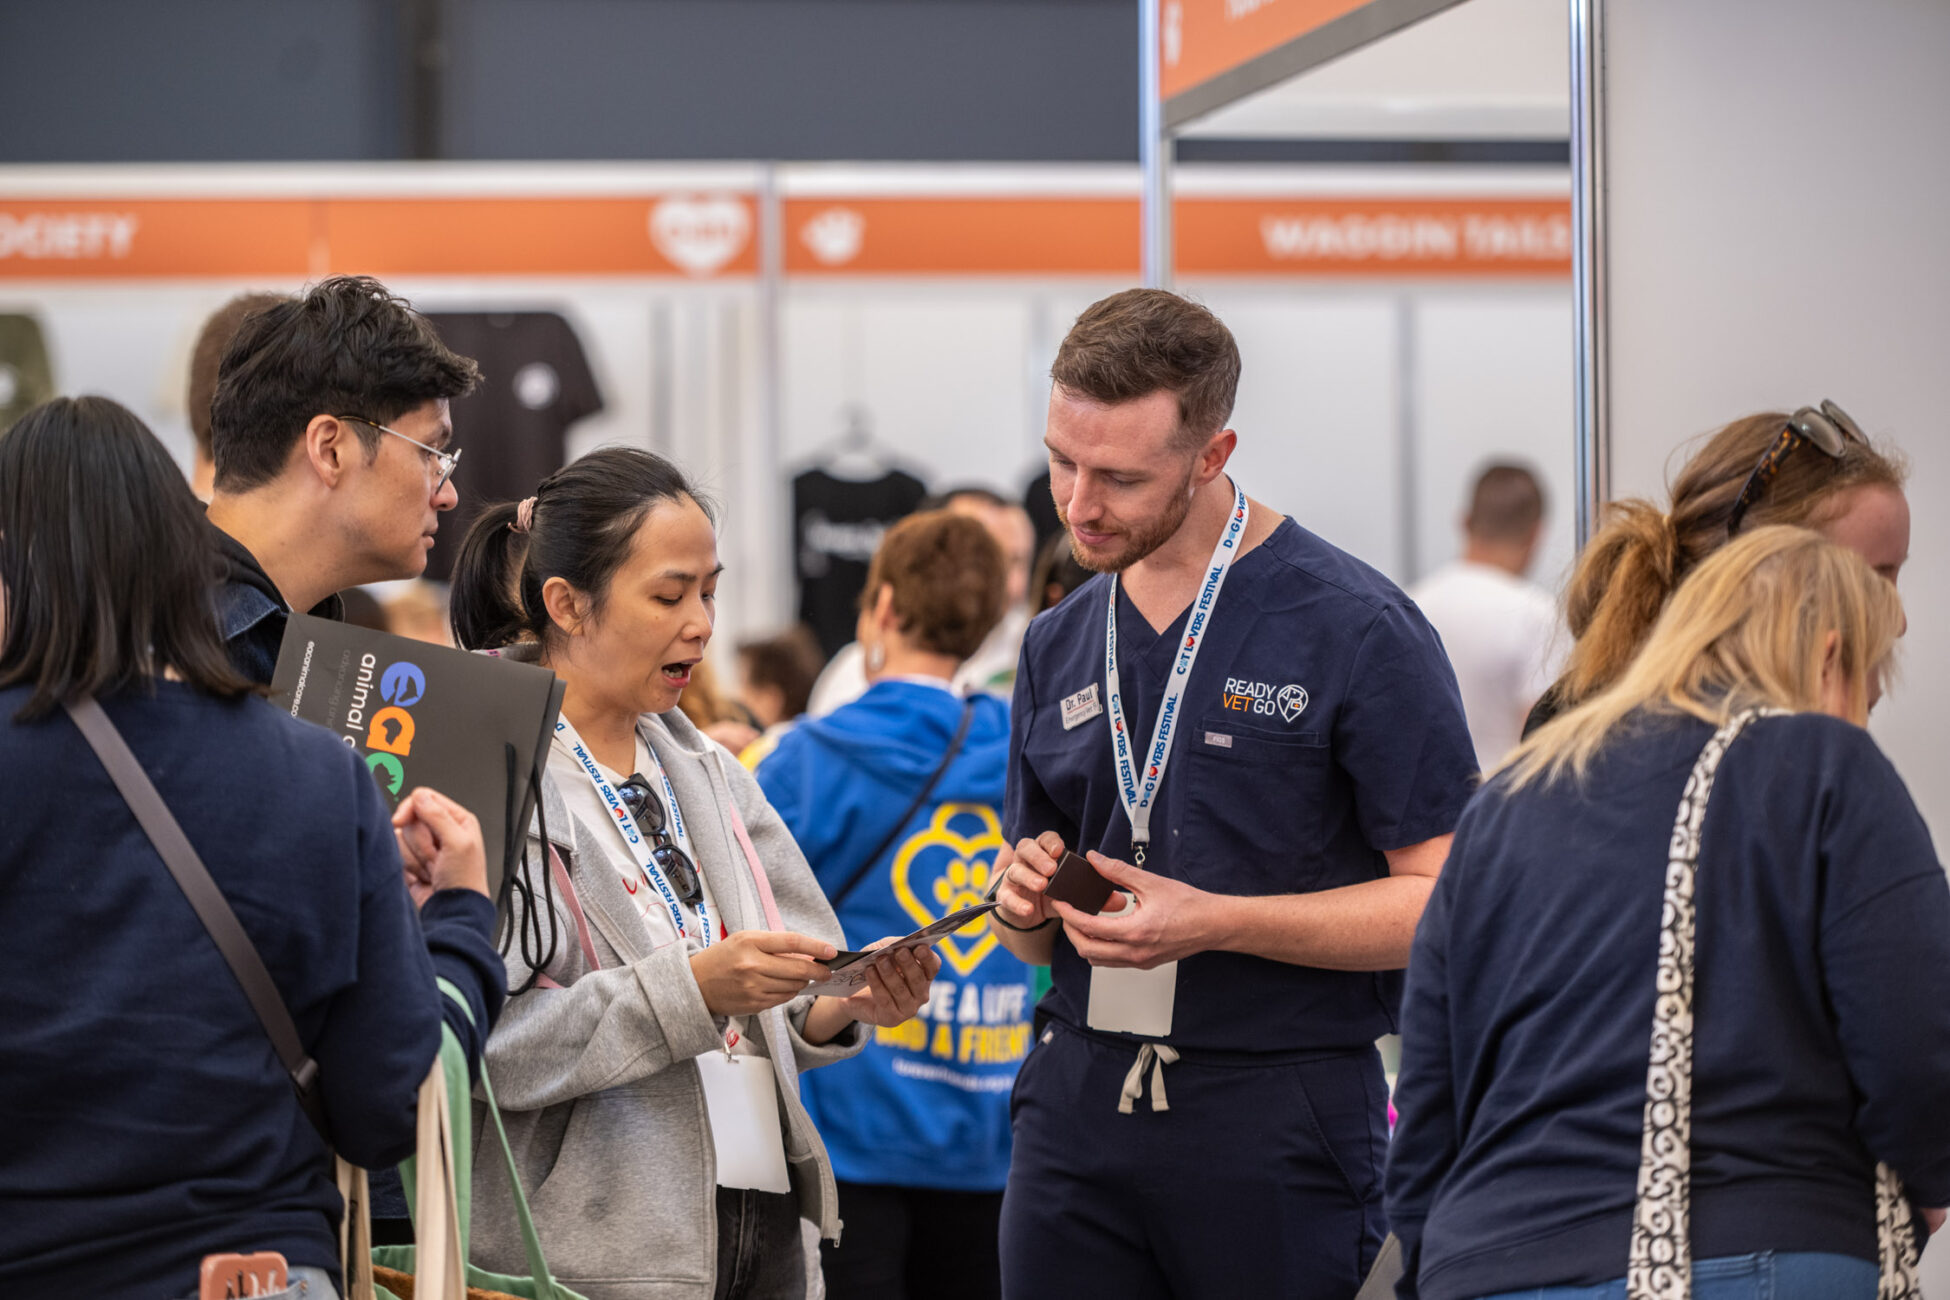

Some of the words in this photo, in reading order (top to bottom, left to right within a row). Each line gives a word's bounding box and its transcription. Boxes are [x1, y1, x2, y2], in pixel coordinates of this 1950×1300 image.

[1259, 213, 1458, 259] WAGGIN
[1199, 565, 1224, 610] FESTIVAL
[290, 641, 315, 718] eacanimalcare.co
[346, 653, 376, 731] animal
[1065, 698, 1076, 711] Dr.
[1077, 687, 1093, 705] Paul
[1224, 677, 1277, 700] READY
[1158, 693, 1178, 741] FESTIVAL
[1223, 692, 1255, 712] VET
[1253, 698, 1276, 716] GO
[573, 742, 605, 784] FESTIVAL
[1119, 759, 1138, 808] FESTIVAL
[645, 859, 675, 903] FESTIVAL
[956, 982, 980, 1023] A
[982, 983, 1028, 1024] LIFE
[930, 1021, 954, 1059] A
